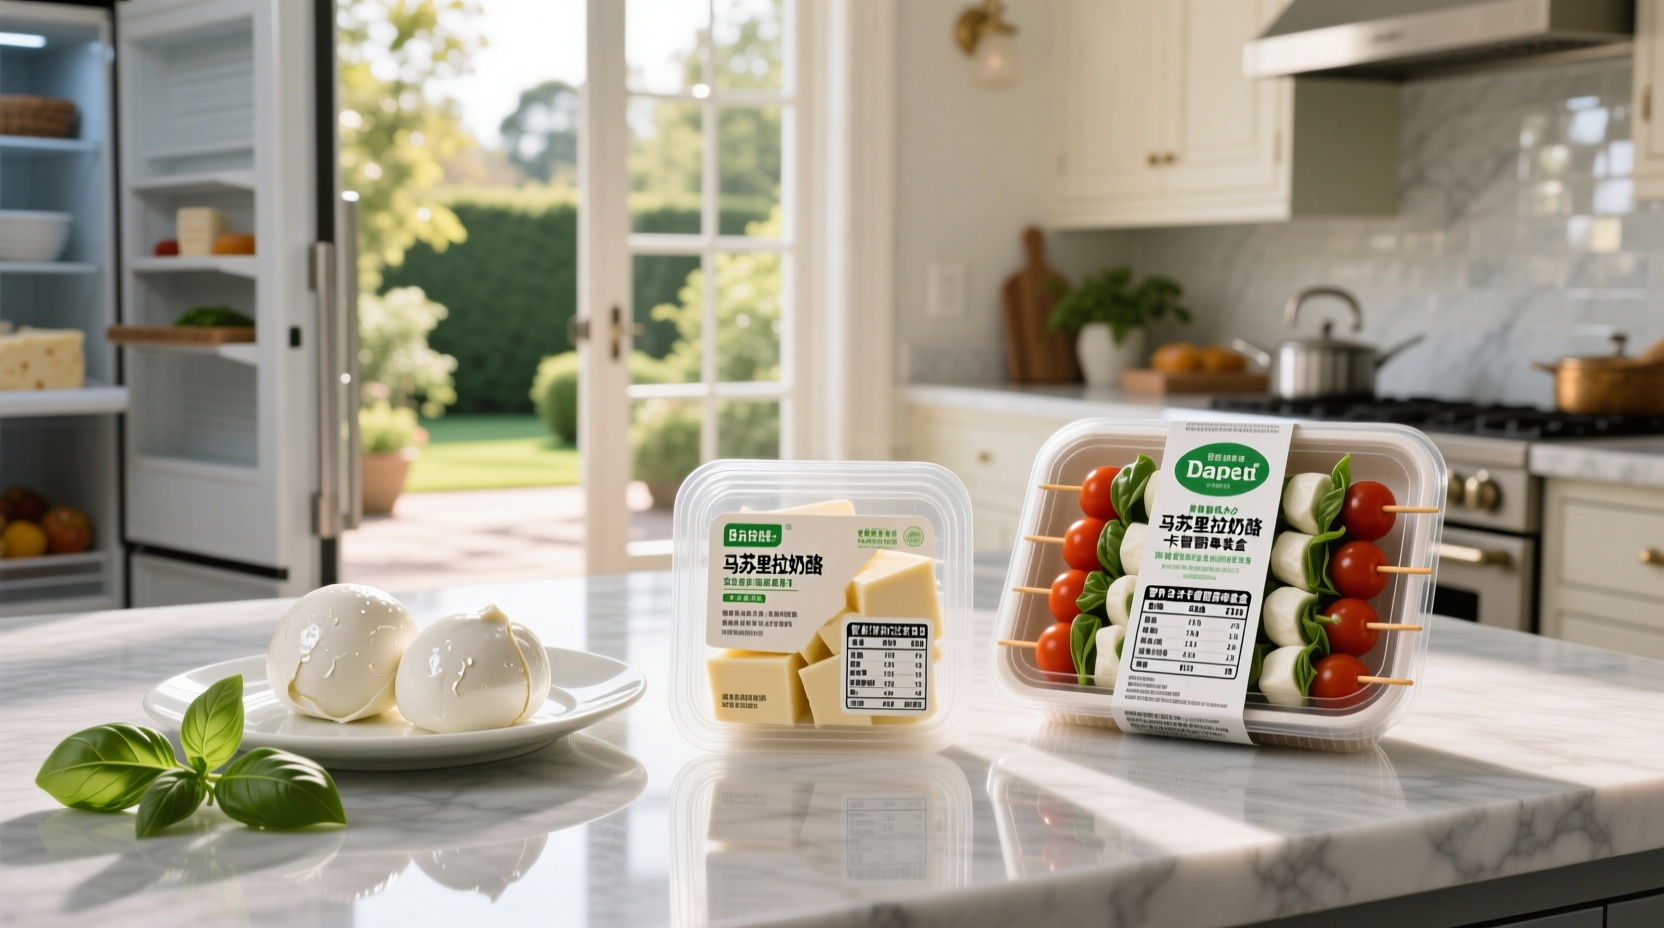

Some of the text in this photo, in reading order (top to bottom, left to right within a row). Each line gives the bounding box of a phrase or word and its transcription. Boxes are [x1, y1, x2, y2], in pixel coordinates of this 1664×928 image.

[1159, 514, 1263, 537] 马苏里拉奶酪
[723, 552, 824, 576] 马苏里拉奶酪
